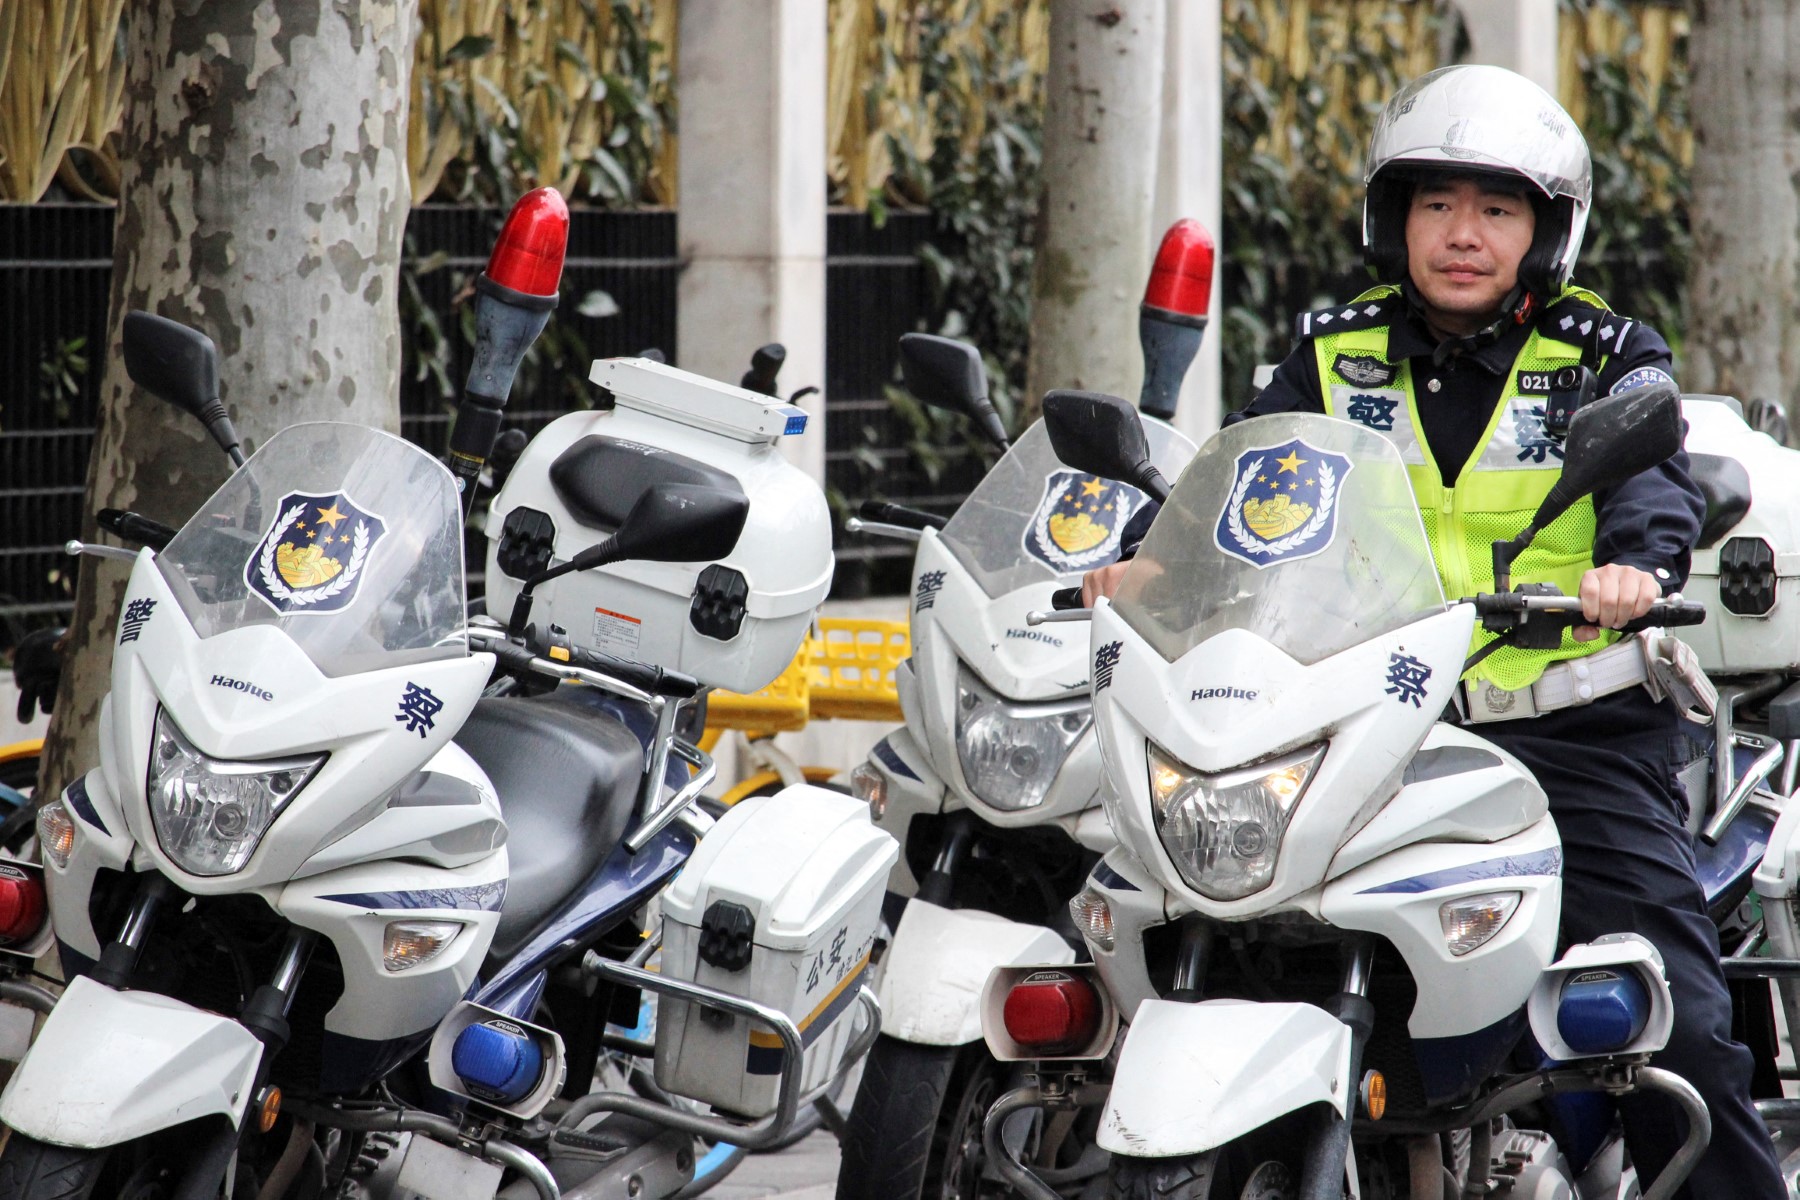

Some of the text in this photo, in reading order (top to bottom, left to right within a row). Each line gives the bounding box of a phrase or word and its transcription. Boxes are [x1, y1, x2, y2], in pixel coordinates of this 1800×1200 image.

[1522, 375, 1551, 390] 021
[1346, 394, 1399, 432] 警
[915, 570, 947, 615] 警
[1005, 628, 1063, 648] Haojue
[119, 597, 444, 739] 警 察
[1094, 640, 1432, 709] 警 察
[210, 674, 274, 702] Haojue
[1190, 686, 1257, 701] Haojue
[805, 926, 848, 996] 公安
[495, 1022, 520, 1034] SPEAKER
